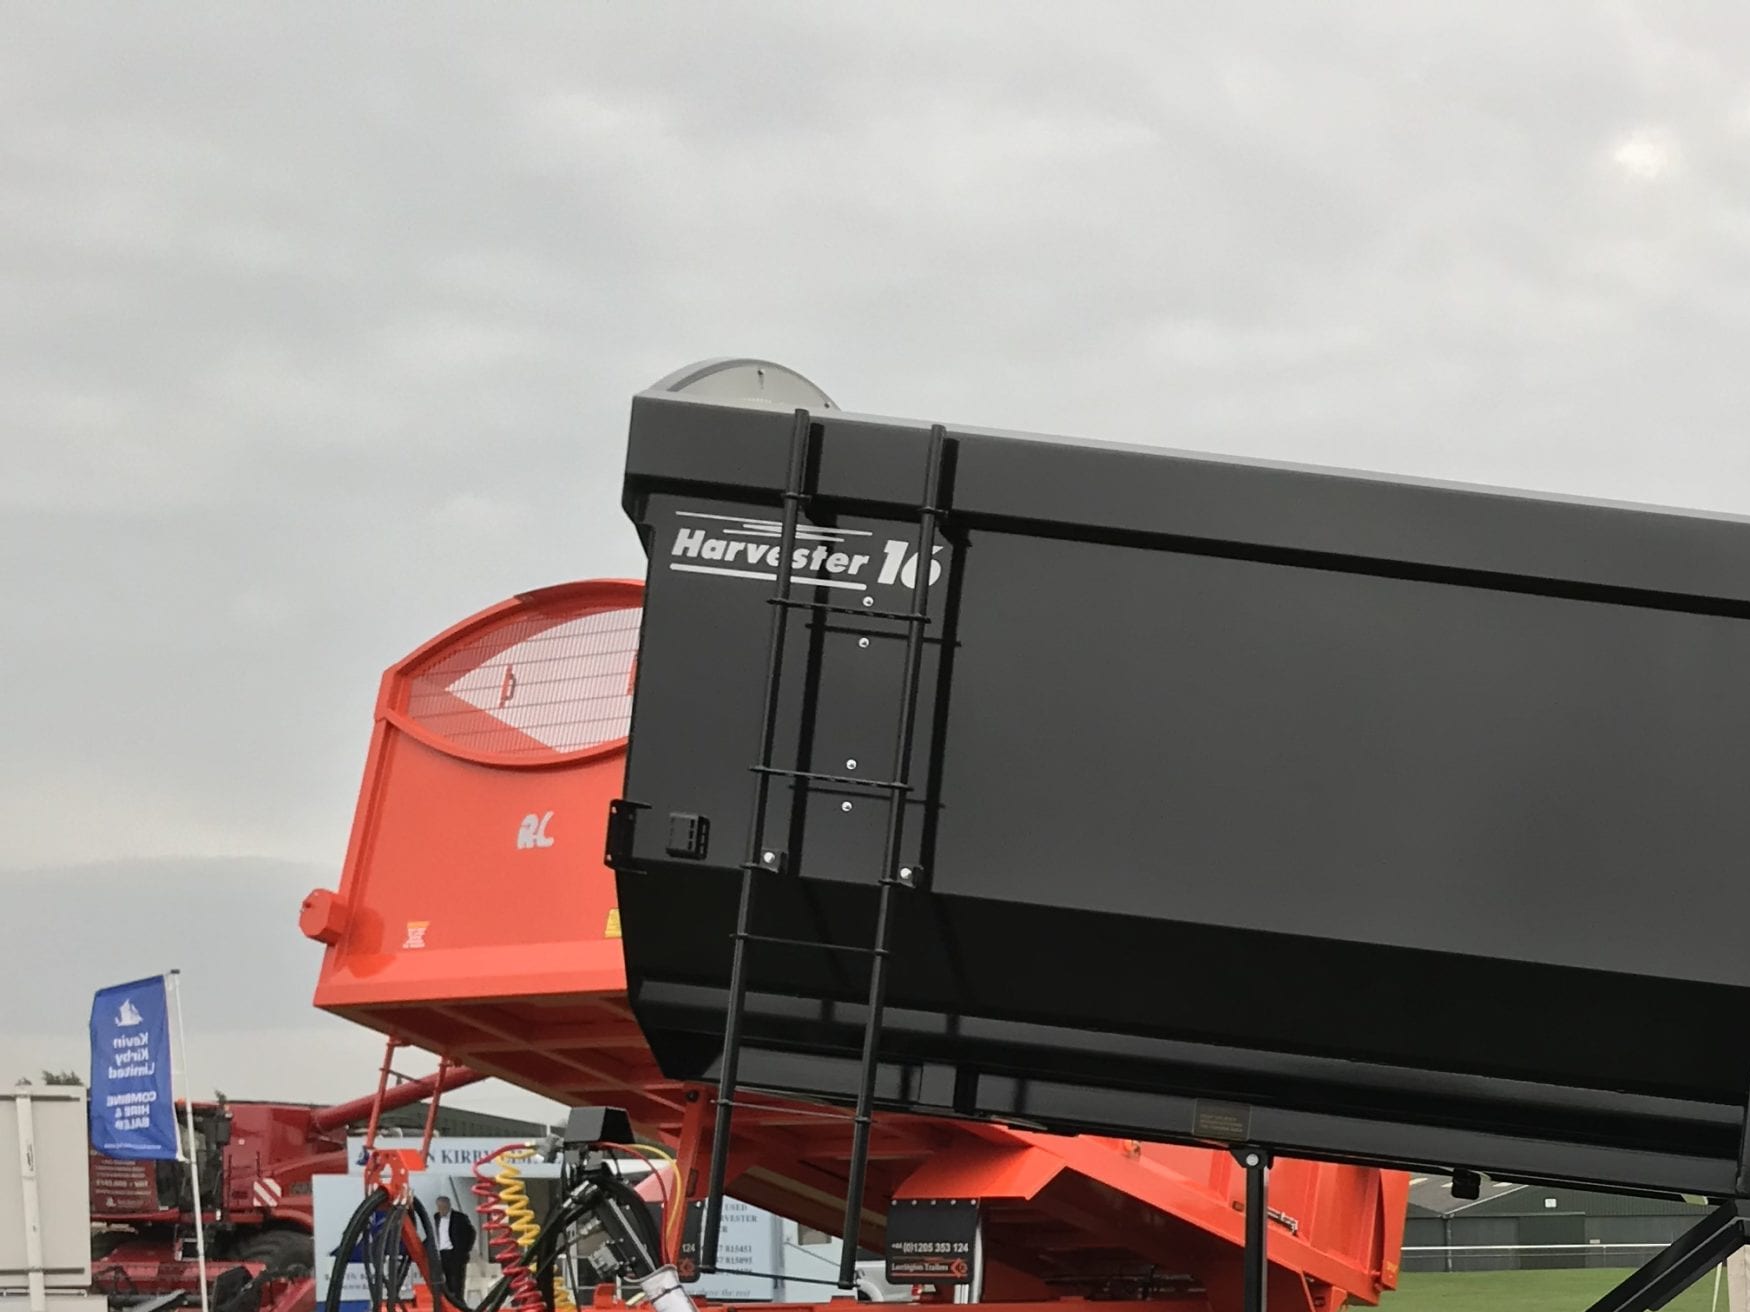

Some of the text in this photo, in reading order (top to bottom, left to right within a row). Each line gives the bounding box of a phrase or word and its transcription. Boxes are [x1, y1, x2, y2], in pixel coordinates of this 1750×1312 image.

[671, 528, 944, 589] Harvester 16
[953, 1243, 969, 1253] 124
